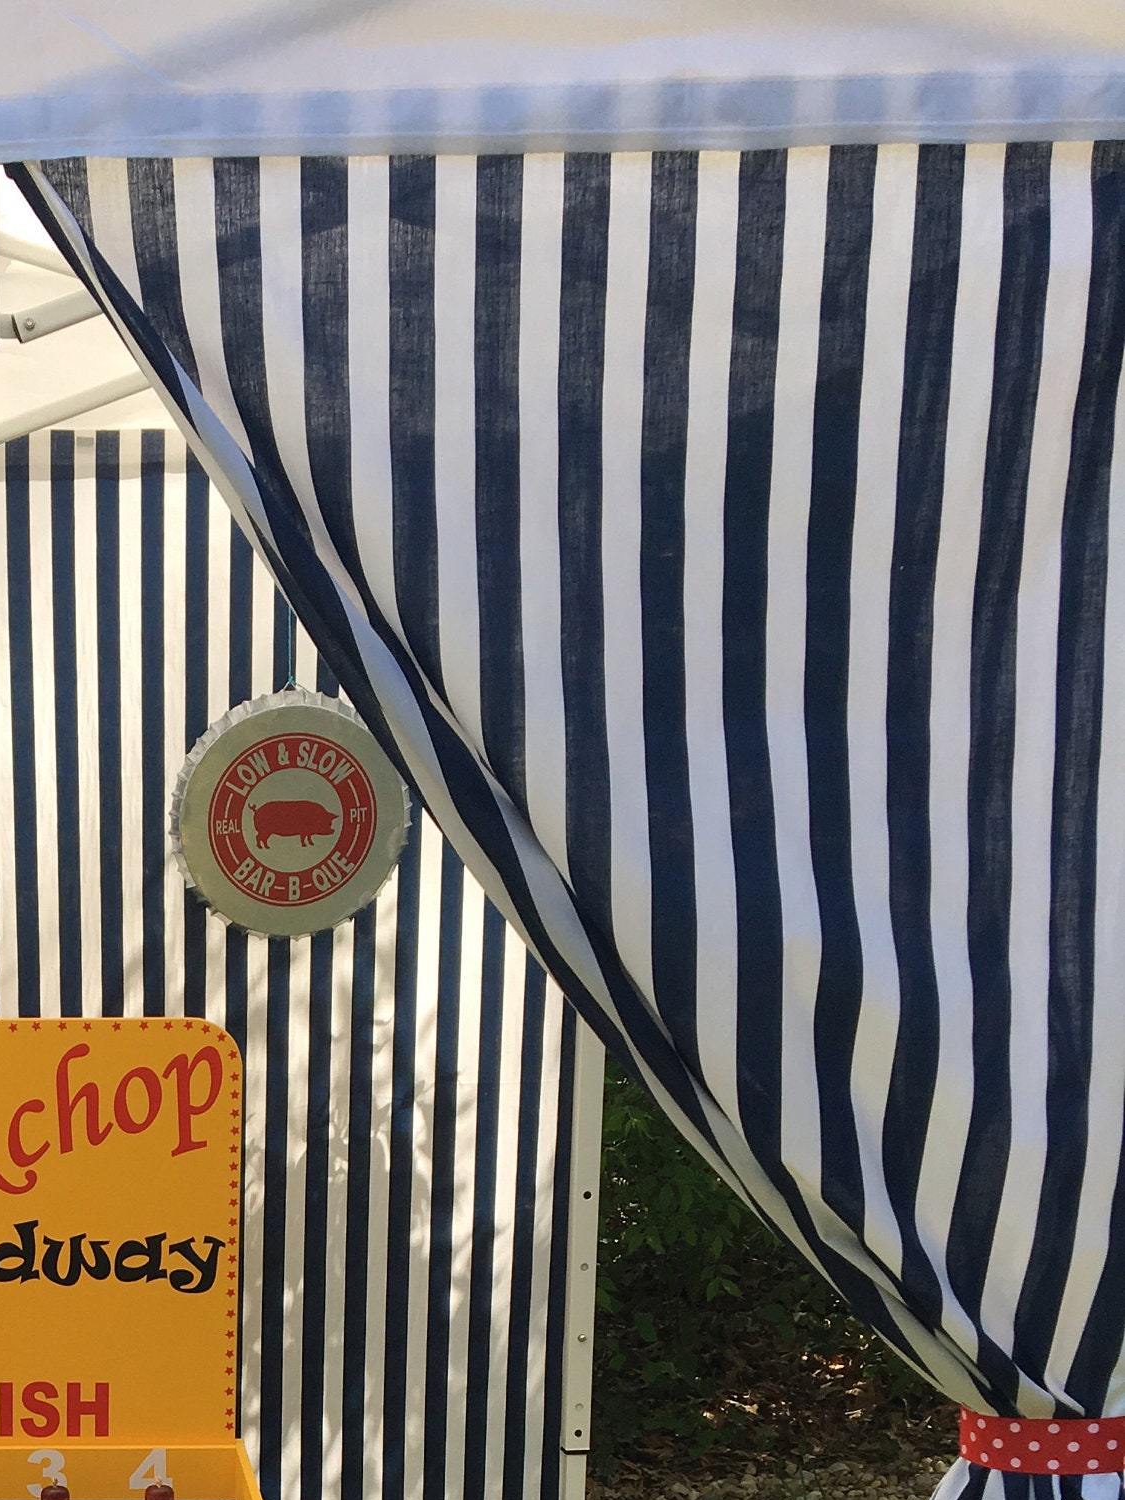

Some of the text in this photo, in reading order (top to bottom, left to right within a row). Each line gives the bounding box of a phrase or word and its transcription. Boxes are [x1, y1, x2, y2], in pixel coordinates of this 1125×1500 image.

[226, 741, 355, 796] LOW & SLOW
[216, 820, 240, 835] REAL
[350, 807, 368, 824] PIT
[26, 1448, 68, 1500] 3
[128, 1448, 173, 1490] 4
